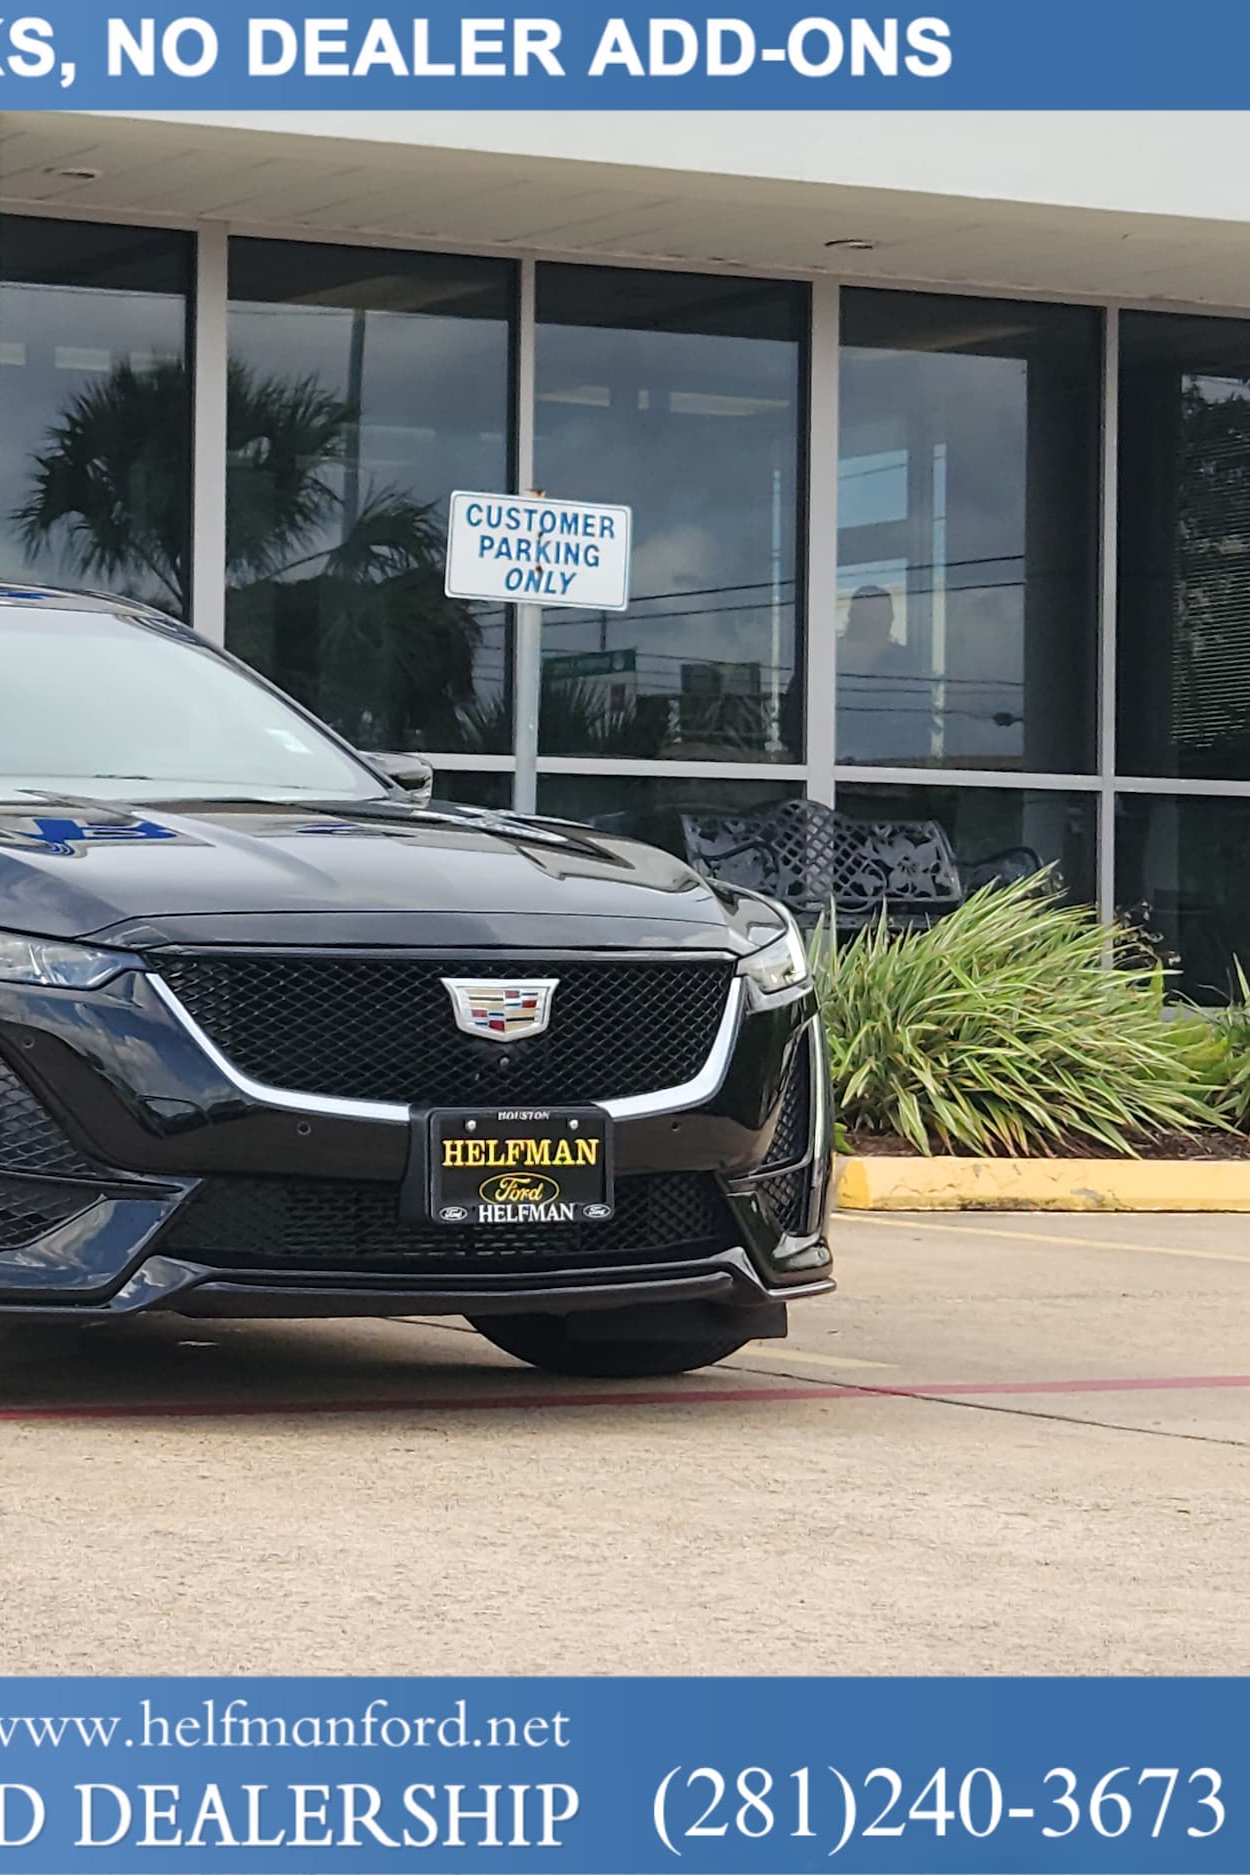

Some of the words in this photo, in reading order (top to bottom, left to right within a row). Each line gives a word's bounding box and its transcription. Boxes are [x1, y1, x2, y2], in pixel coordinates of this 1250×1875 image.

[465, 503, 615, 540] CUSTOMER
[478, 535, 600, 568] PARKING
[504, 567, 577, 595] ONLY
[497, 1111, 551, 1121] HOUSTON
[441, 1138, 600, 1168] HELFMAN
[494, 1176, 545, 1201] Ford
[478, 1203, 576, 1223] HELFMAN
